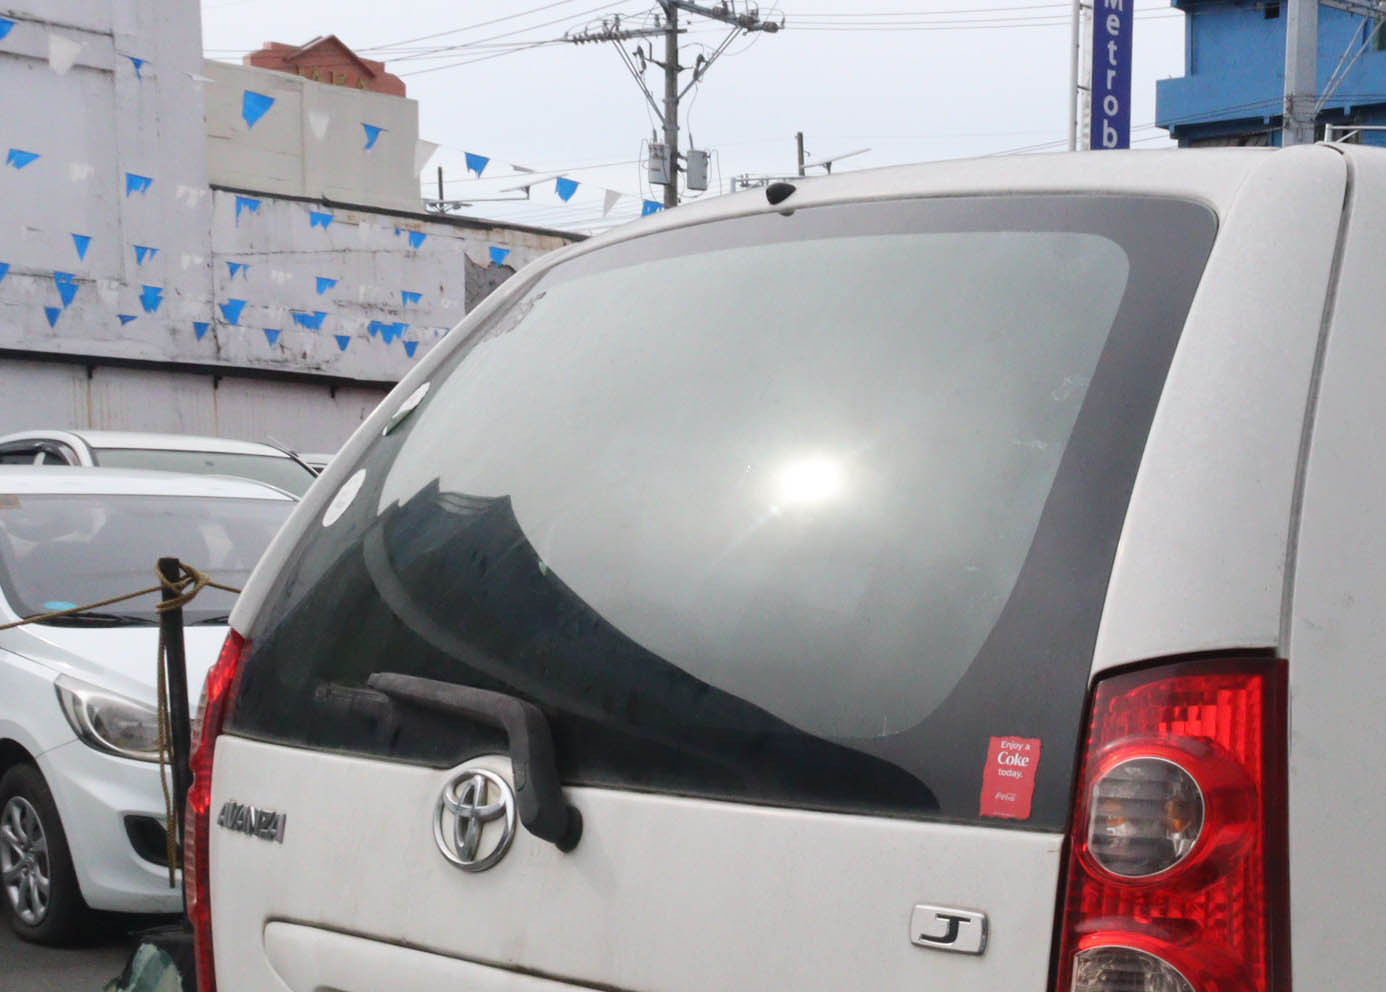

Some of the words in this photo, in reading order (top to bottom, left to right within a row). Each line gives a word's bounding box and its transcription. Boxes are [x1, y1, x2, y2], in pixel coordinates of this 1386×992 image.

[1001, 740, 1022, 751] Enjoy
[997, 751, 1030, 767] Coke
[998, 768, 1024, 779] today.
[217, 801, 286, 845] AVANZA
[919, 913, 971, 944] J
